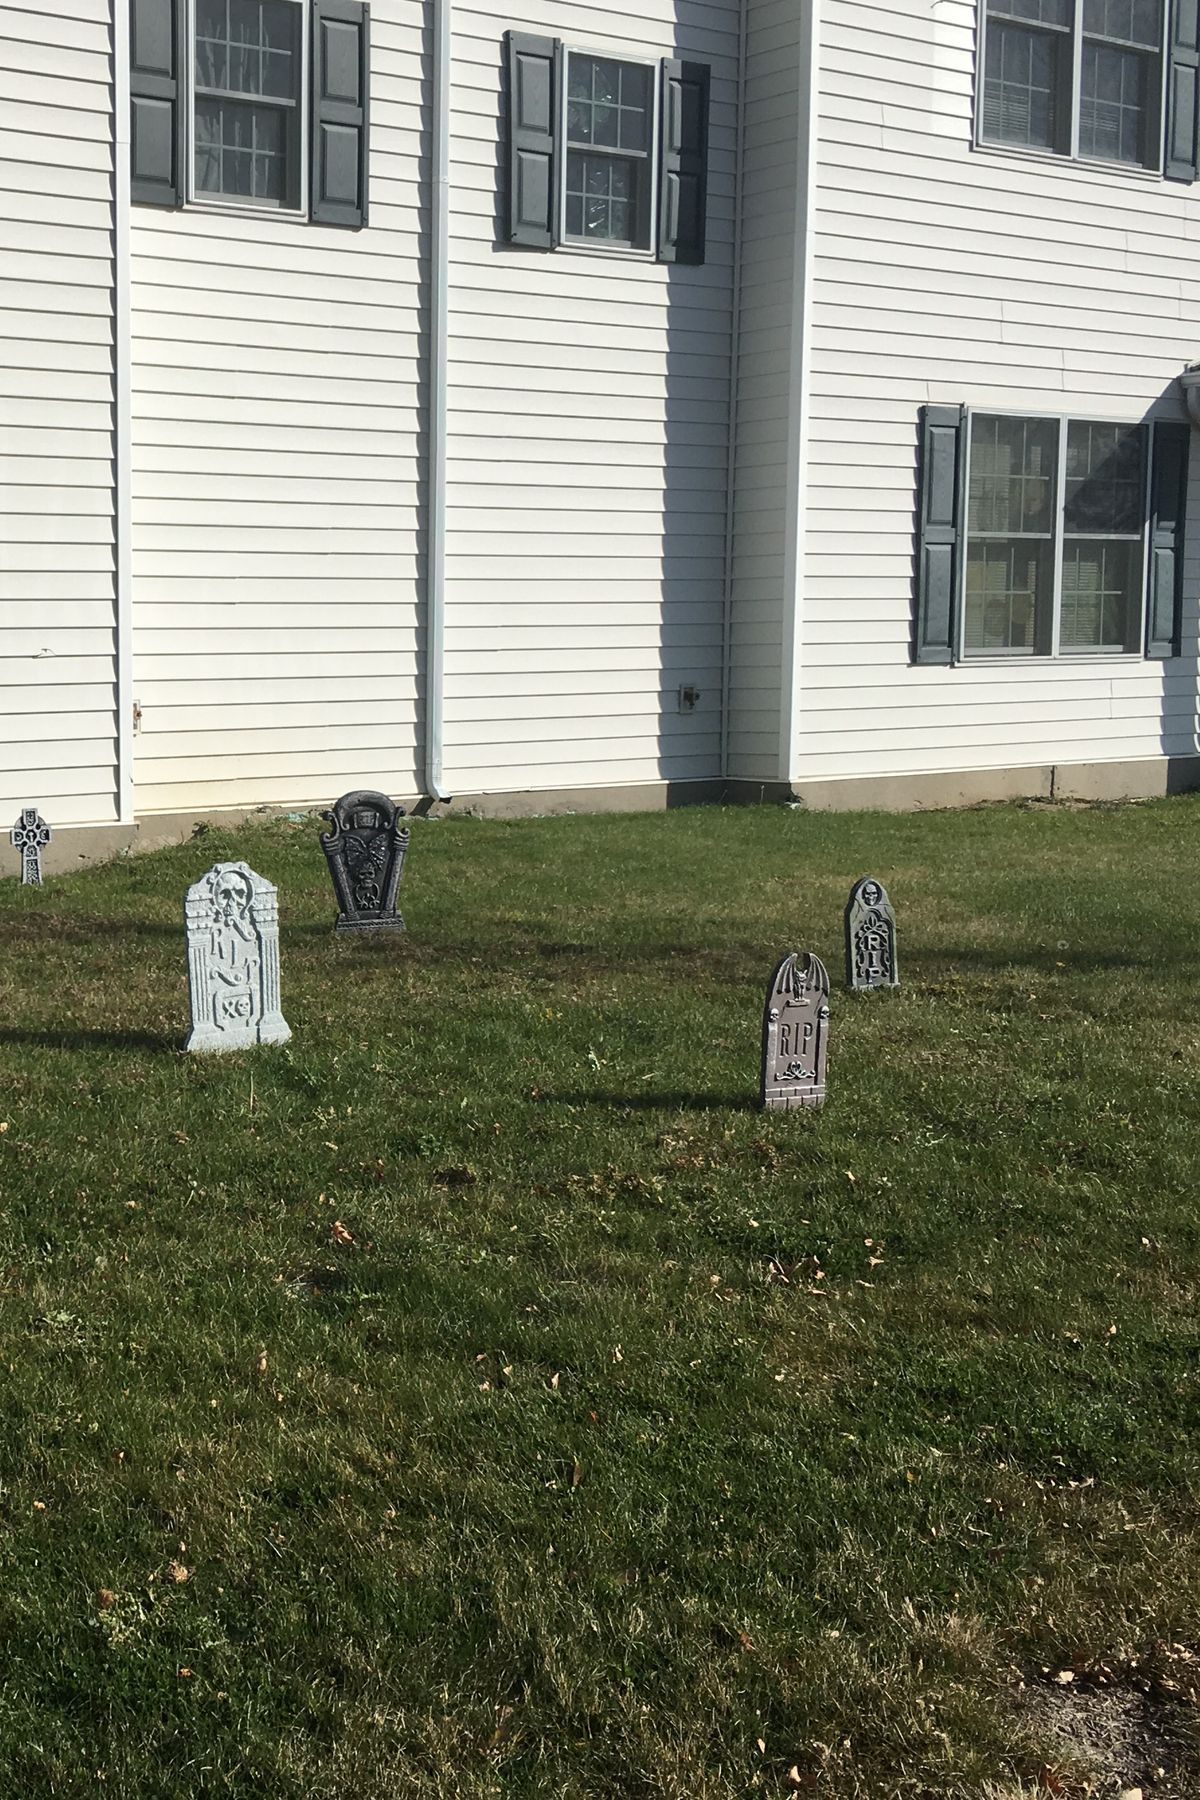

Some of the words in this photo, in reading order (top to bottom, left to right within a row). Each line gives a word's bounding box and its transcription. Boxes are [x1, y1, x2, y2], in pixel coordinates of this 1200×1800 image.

[209, 928, 260, 985] RIP
[868, 935, 886, 983] RIP
[779, 1022, 813, 1058] RIP
